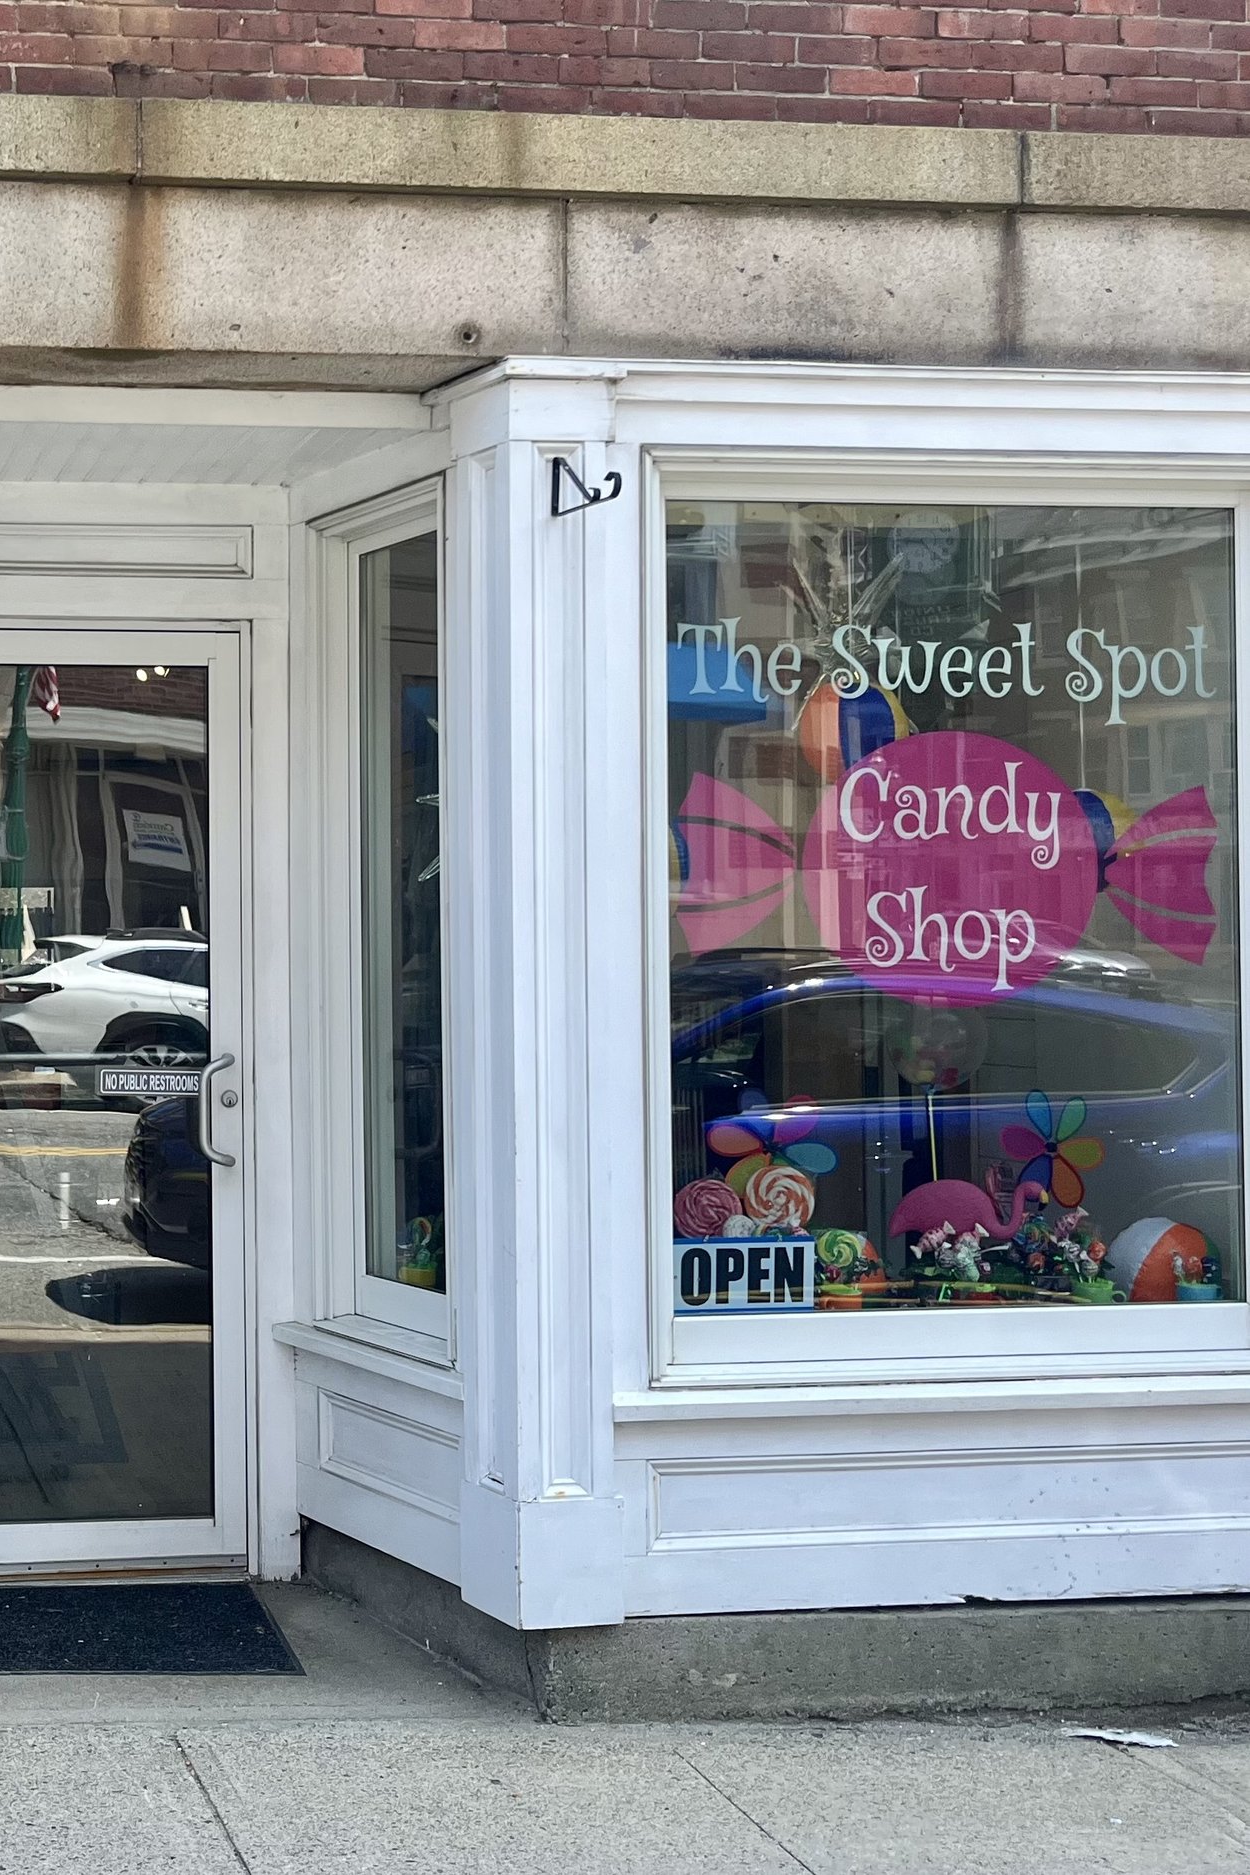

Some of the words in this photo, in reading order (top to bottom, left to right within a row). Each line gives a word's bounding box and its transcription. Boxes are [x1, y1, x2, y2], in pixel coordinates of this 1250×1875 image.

[677, 616, 802, 703] The
[830, 621, 1044, 700] Sweet
[1065, 625, 1217, 726] Spot
[839, 761, 1062, 870] Candy
[865, 886, 1036, 993] Shop
[105, 1074, 117, 1090] NO
[119, 1074, 148, 1091] PUBLIC
[150, 1074, 199, 1092] RESTROOMS
[680, 1247, 805, 1306] OPEN
